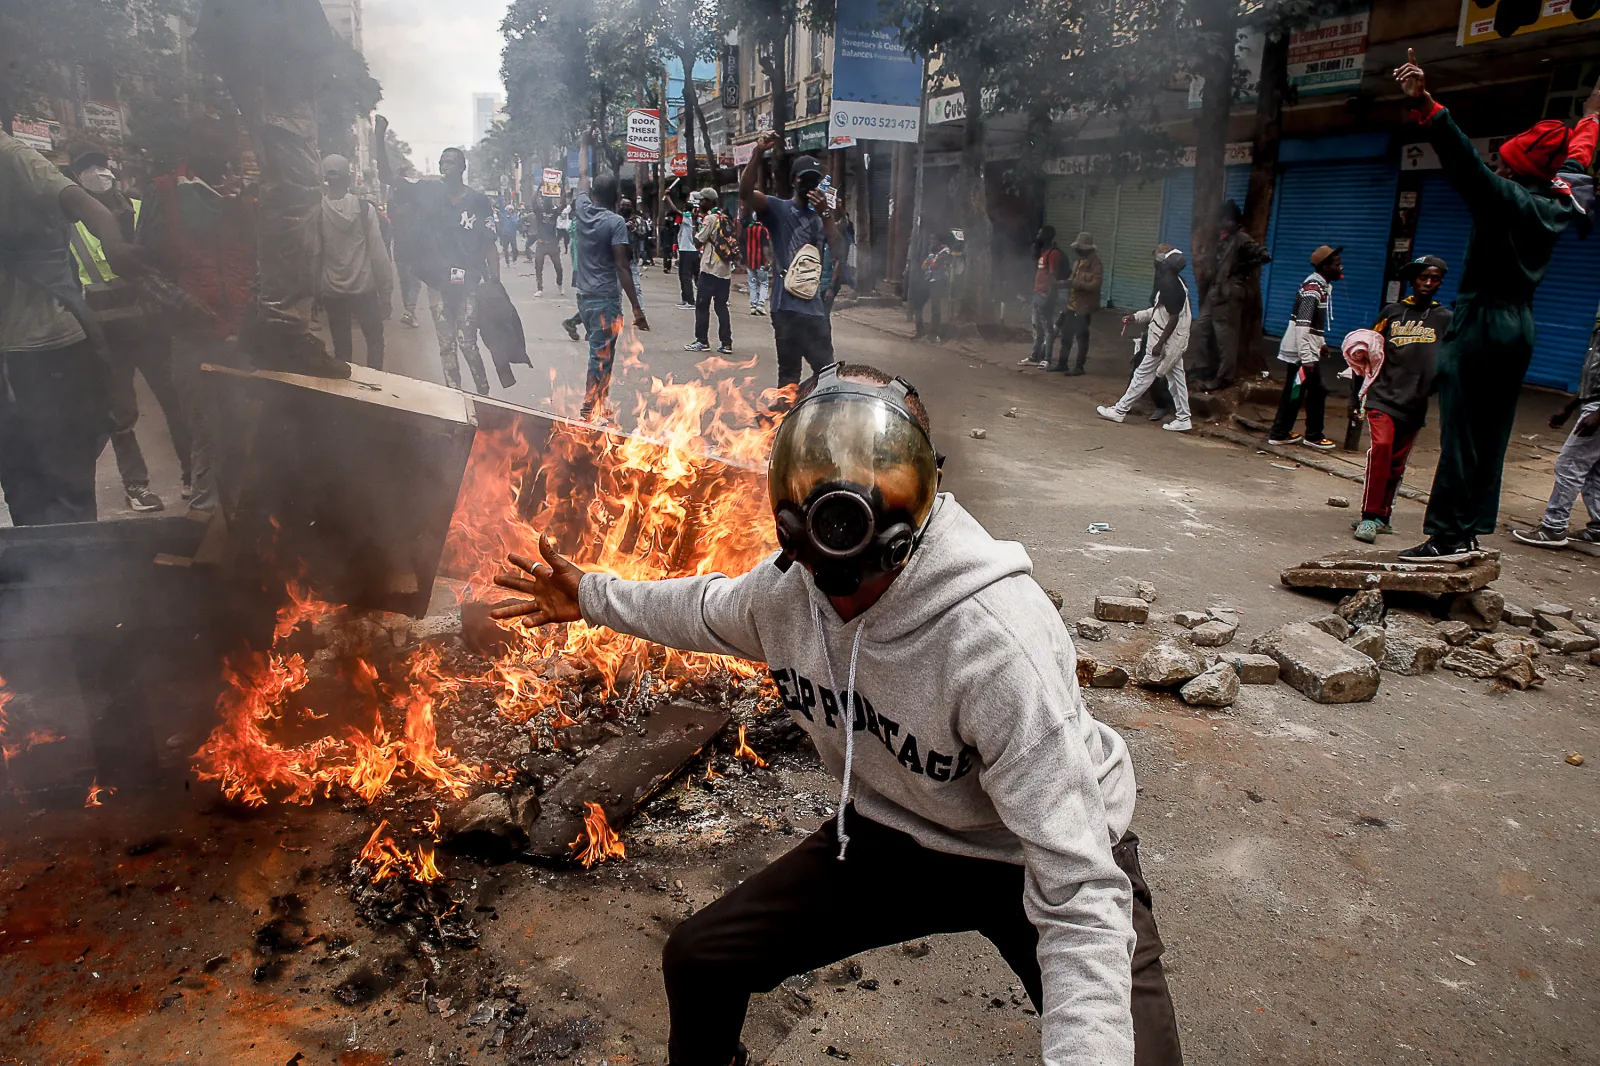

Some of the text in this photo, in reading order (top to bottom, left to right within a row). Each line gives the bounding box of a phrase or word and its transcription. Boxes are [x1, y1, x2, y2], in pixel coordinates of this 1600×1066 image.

[1299, 26, 1338, 42] COMPUTER
[1339, 20, 1363, 36] SALES
[841, 38, 876, 49] Inventory
[883, 42, 906, 52] Custo
[841, 48, 873, 59] Balances
[1319, 59, 1341, 72] FLOOR
[852, 116, 916, 130] 0703 523 473
[630, 126, 656, 134] THESE
[628, 135, 659, 143] SPACES
[1391, 320, 1435, 337] Bulldogs
